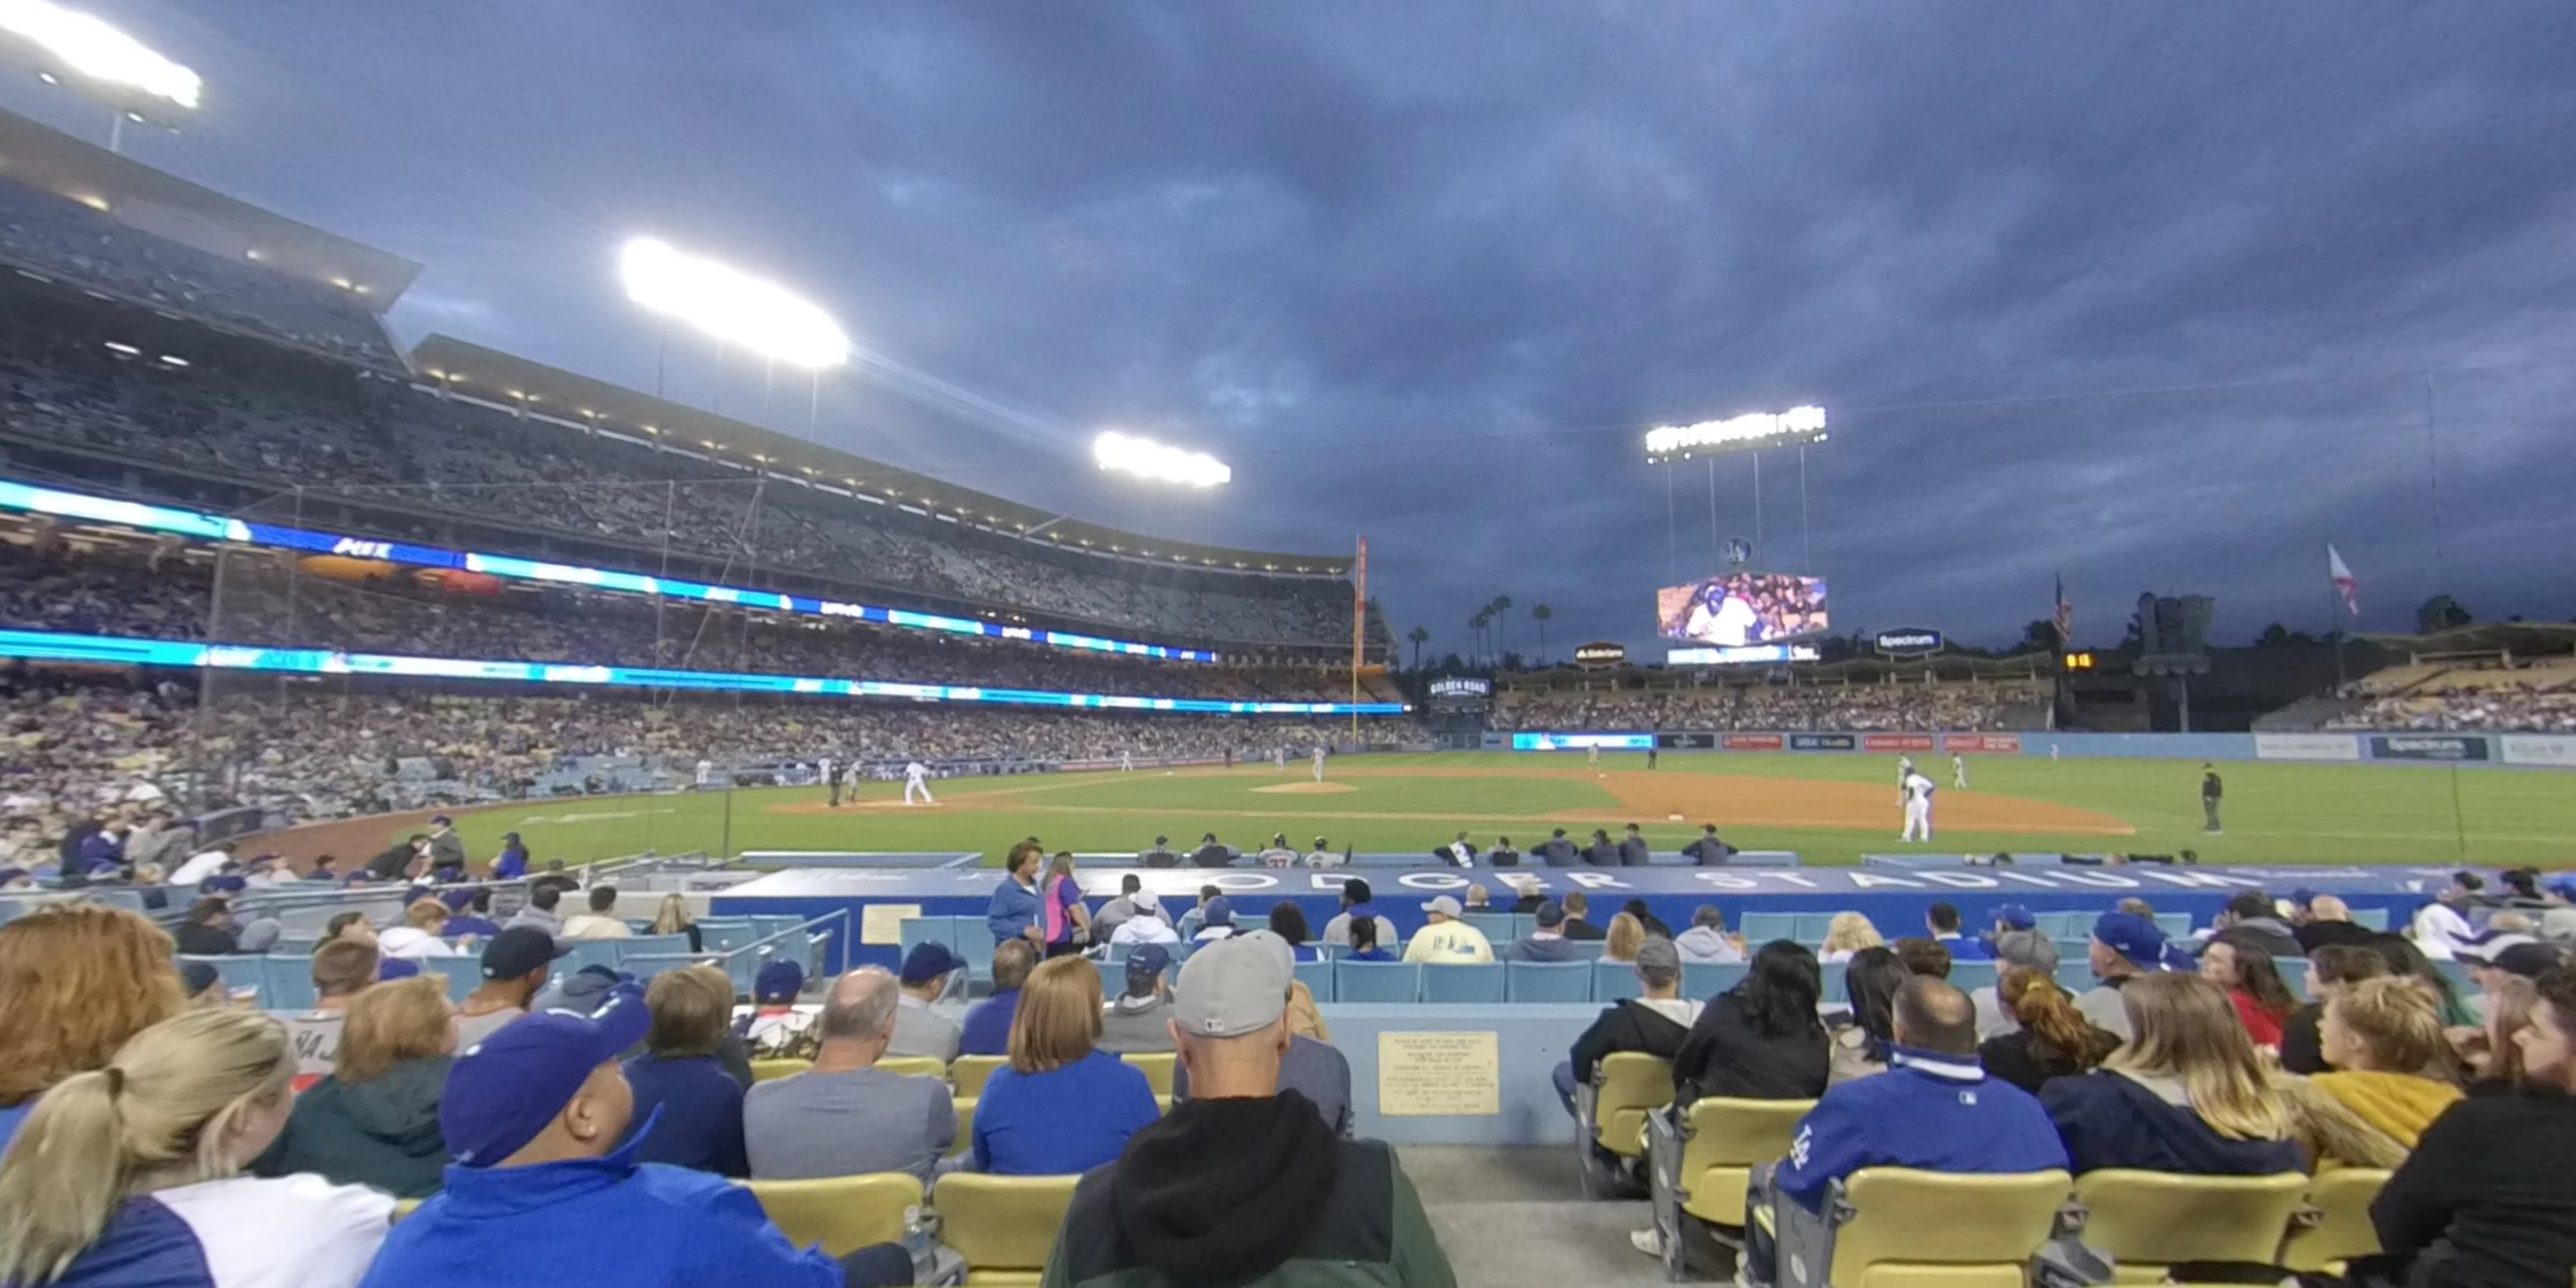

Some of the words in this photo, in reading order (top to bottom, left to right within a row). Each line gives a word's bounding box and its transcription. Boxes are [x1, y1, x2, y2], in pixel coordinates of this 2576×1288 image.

[1879, 636, 1935, 648] Spectrum
[1430, 680, 1463, 694] GOLDEN
[1463, 680, 1486, 693] ROAD
[1209, 873, 1631, 890] ODGER
[1695, 870, 2263, 889] STADIUM
[1789, 1124, 1813, 1171] LA
